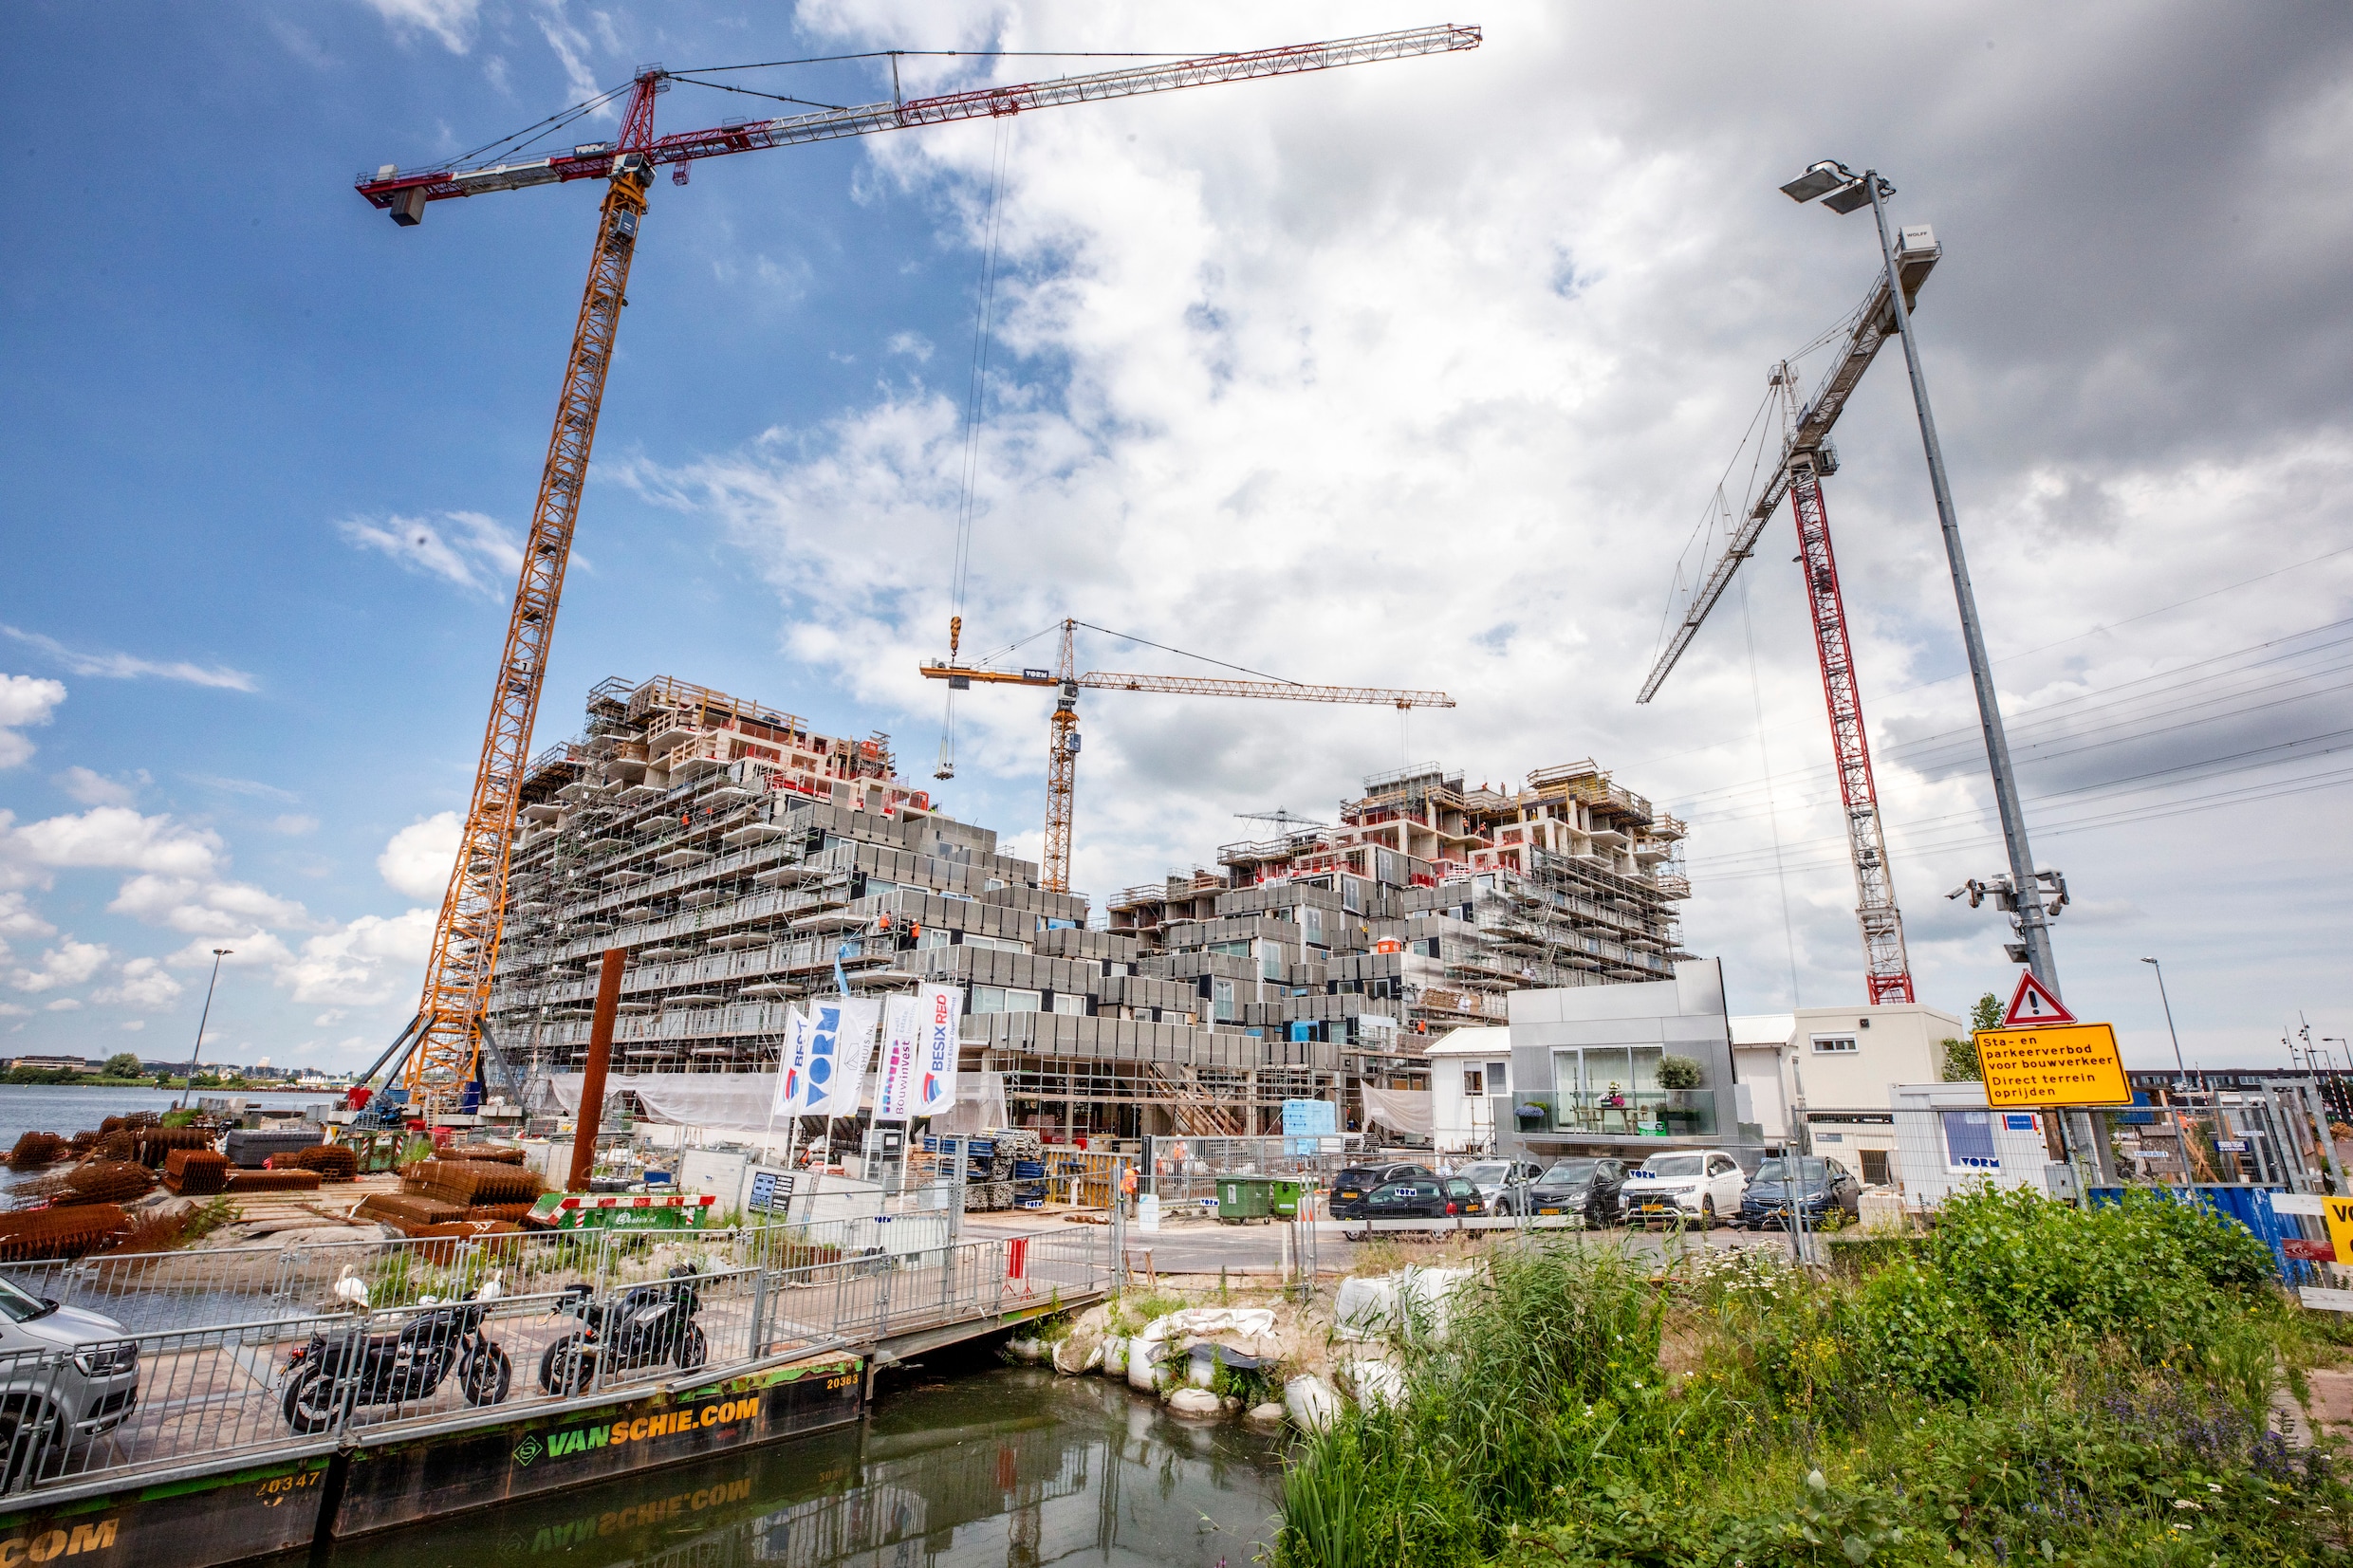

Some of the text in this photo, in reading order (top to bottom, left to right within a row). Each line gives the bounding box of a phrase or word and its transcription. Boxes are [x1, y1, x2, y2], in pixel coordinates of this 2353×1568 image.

[1025, 670, 1048, 678] VORM
[932, 993, 948, 1071] BESIX RED
[1983, 1037, 2037, 1047] Sta- en
[806, 1006, 841, 1108] VORM
[1986, 1044, 2092, 1060] parkeerverbod
[1989, 1057, 2113, 1070] voor bouwverkeer
[896, 1040, 911, 1115] Bouwinvest
[1992, 1073, 2096, 1086] Direct terrein
[1994, 1087, 2056, 1099] oprijden
[1961, 1158, 2000, 1168] VORM
[826, 1374, 859, 1390] 20383
[547, 1397, 760, 1459] VANSCHIE.COM
[255, 1470, 321, 1497] 20347
